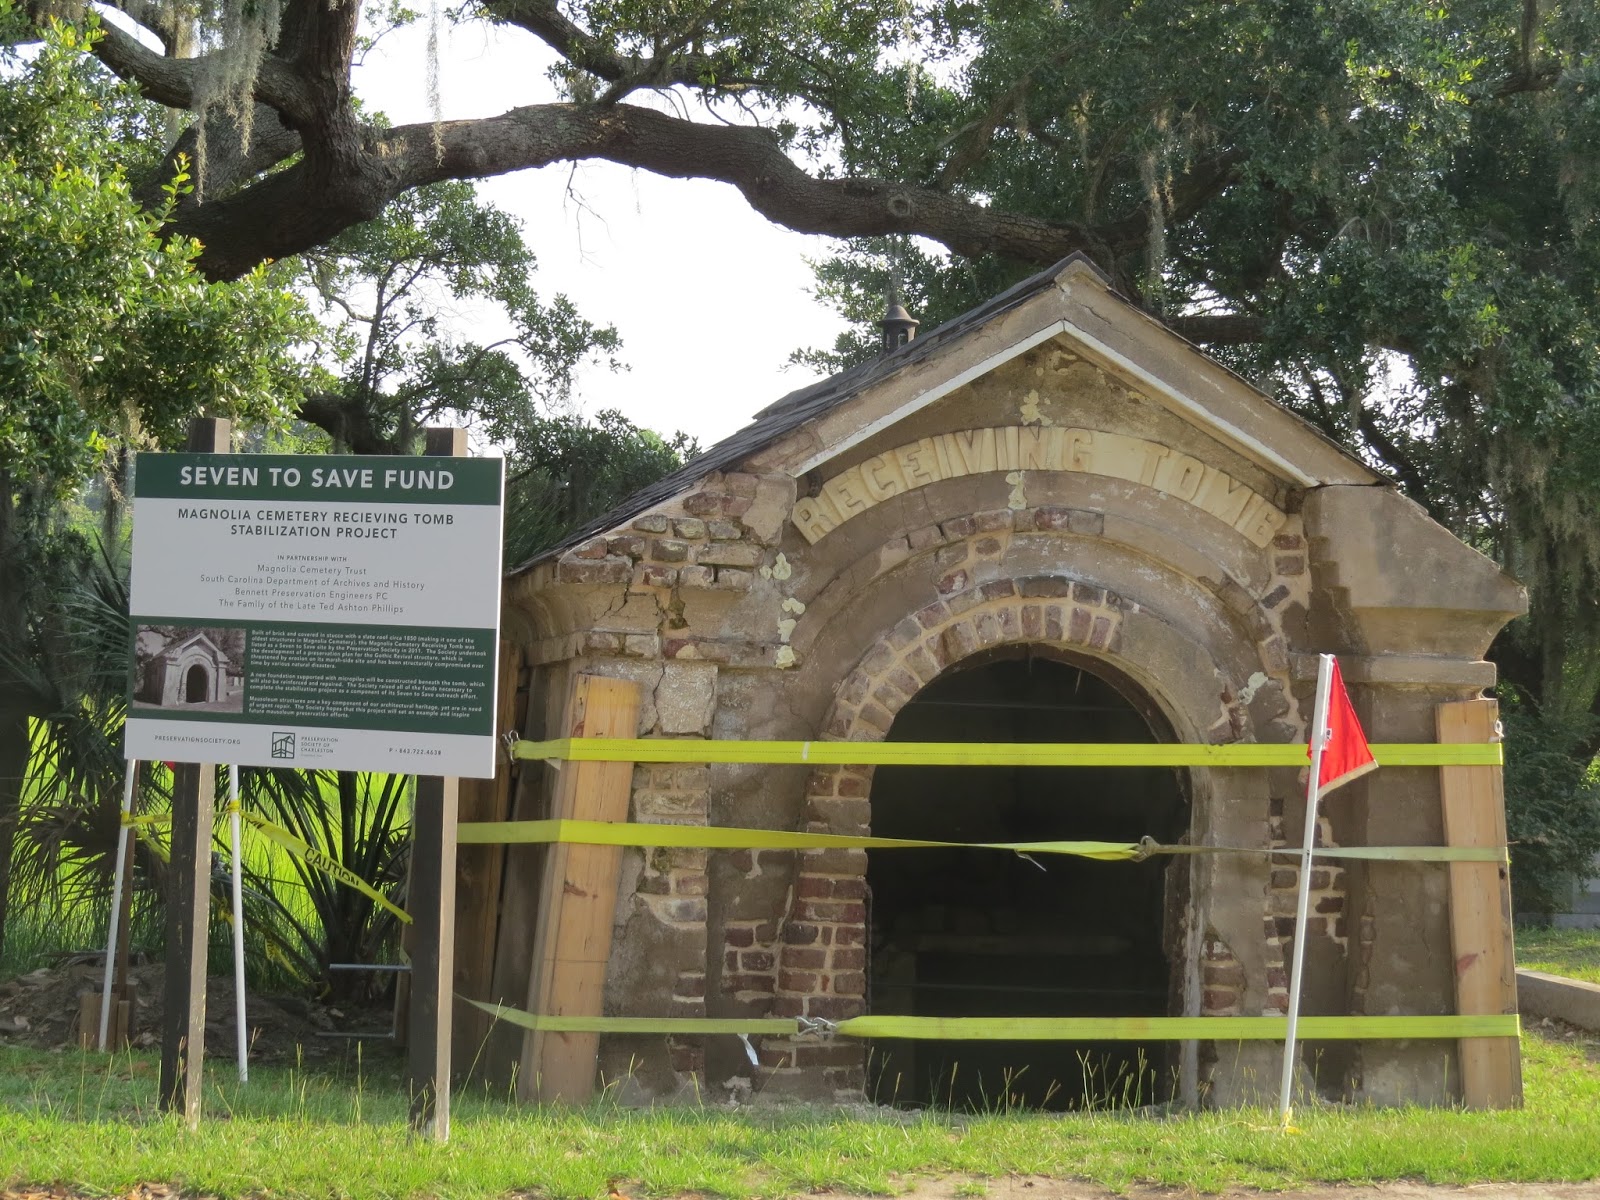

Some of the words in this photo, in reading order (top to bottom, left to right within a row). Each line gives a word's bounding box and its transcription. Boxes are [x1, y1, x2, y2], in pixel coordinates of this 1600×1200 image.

[180, 466, 258, 486] SEVEN
[268, 467, 300, 487] TO
[311, 468, 373, 488] SAVE
[384, 469, 453, 489] FUND
[791, 426, 1092, 545] RECEIVING
[1138, 440, 1287, 549] TOMB
[178, 508, 251, 520] MAGNOLIA
[256, 510, 327, 522] CEMETERY
[333, 511, 407, 523] RECIEVING
[413, 513, 453, 524] TOMB
[230, 524, 330, 537] STABILIZATION
[336, 526, 397, 539] PROJECT
[257, 564, 296, 575] Magnolia
[299, 564, 342, 576] Cemetery
[344, 566, 366, 575] Trust
[200, 573, 224, 582] South
[227, 574, 263, 584] Carolina
[266, 576, 317, 586] Department
[320, 577, 330, 586] of
[332, 578, 370, 587] Archives
[373, 579, 389, 588] and
[392, 580, 424, 591] History
[234, 587, 268, 596] Bennett
[271, 588, 326, 598] Preservation
[329, 590, 372, 601] Engineers
[375, 591, 388, 600] PC
[218, 598, 234, 607] The
[236, 599, 265, 610] Family
[267, 600, 276, 608] of
[279, 600, 294, 609] the
[297, 601, 316, 610] Late
[318, 601, 334, 610] Ted
[337, 602, 368, 612] Ashton
[371, 603, 403, 614] Phillips
[154, 734, 240, 745] PRESERVATIONSOCIETY.ORG
